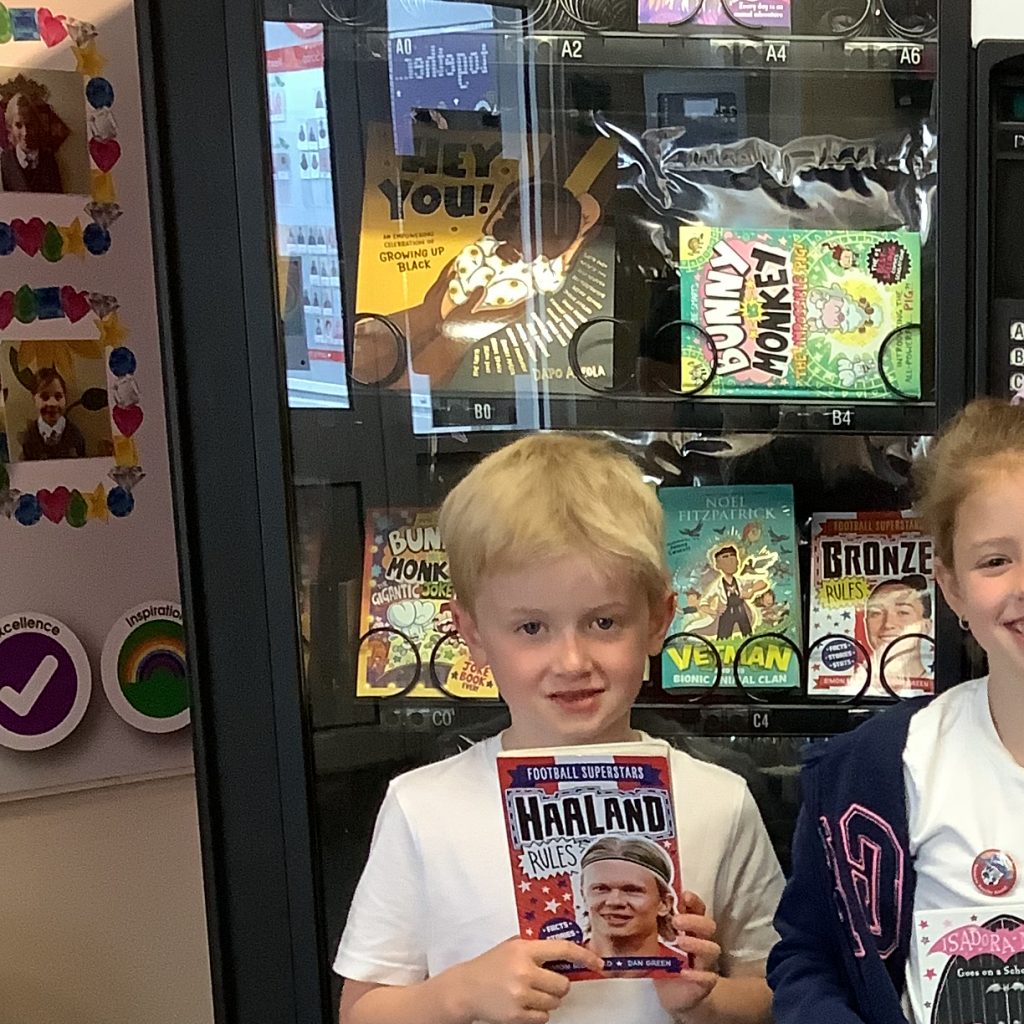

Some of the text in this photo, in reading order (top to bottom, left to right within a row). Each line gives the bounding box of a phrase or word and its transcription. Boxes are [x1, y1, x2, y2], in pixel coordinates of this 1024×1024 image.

[561, 40, 583, 58] A2
[766, 45, 787, 62] A4
[900, 46, 921, 66] A6
[400, 141, 503, 178] HEY
[379, 246, 445, 262] GROWING UP
[396, 260, 431, 273] BLACK
[708, 239, 751, 376] BUNNY
[750, 242, 793, 377] MONKEY
[1014, 324, 1024, 338] A
[1015, 350, 1023, 363] B
[792, 354, 808, 379] THE
[1014, 375, 1023, 389] C
[832, 410, 851, 426] B4
[679, 507, 777, 522] FITZPATRICK
[388, 527, 446, 555] BUN
[821, 540, 933, 578] BRONZE
[387, 556, 450, 582] MONK
[371, 582, 452, 606] GIGANTIC JOKE
[825, 581, 864, 604] RULES
[125, 604, 183, 628] Inspiratio
[0, 616, 61, 637] xcellence
[461, 660, 490, 677] JOKE
[459, 671, 488, 687] BOOK
[673, 674, 710, 685] BIONIC
[757, 673, 787, 685] CLAN
[753, 712, 769, 728] C4
[527, 764, 644, 781] FOOTBALL SUPERSTARS
[513, 794, 667, 841] HAALAND
[528, 844, 577, 874] RULES
[645, 959, 672, 967] GREEN
[956, 967, 980, 977] Goes
[981, 968, 994, 977] on
